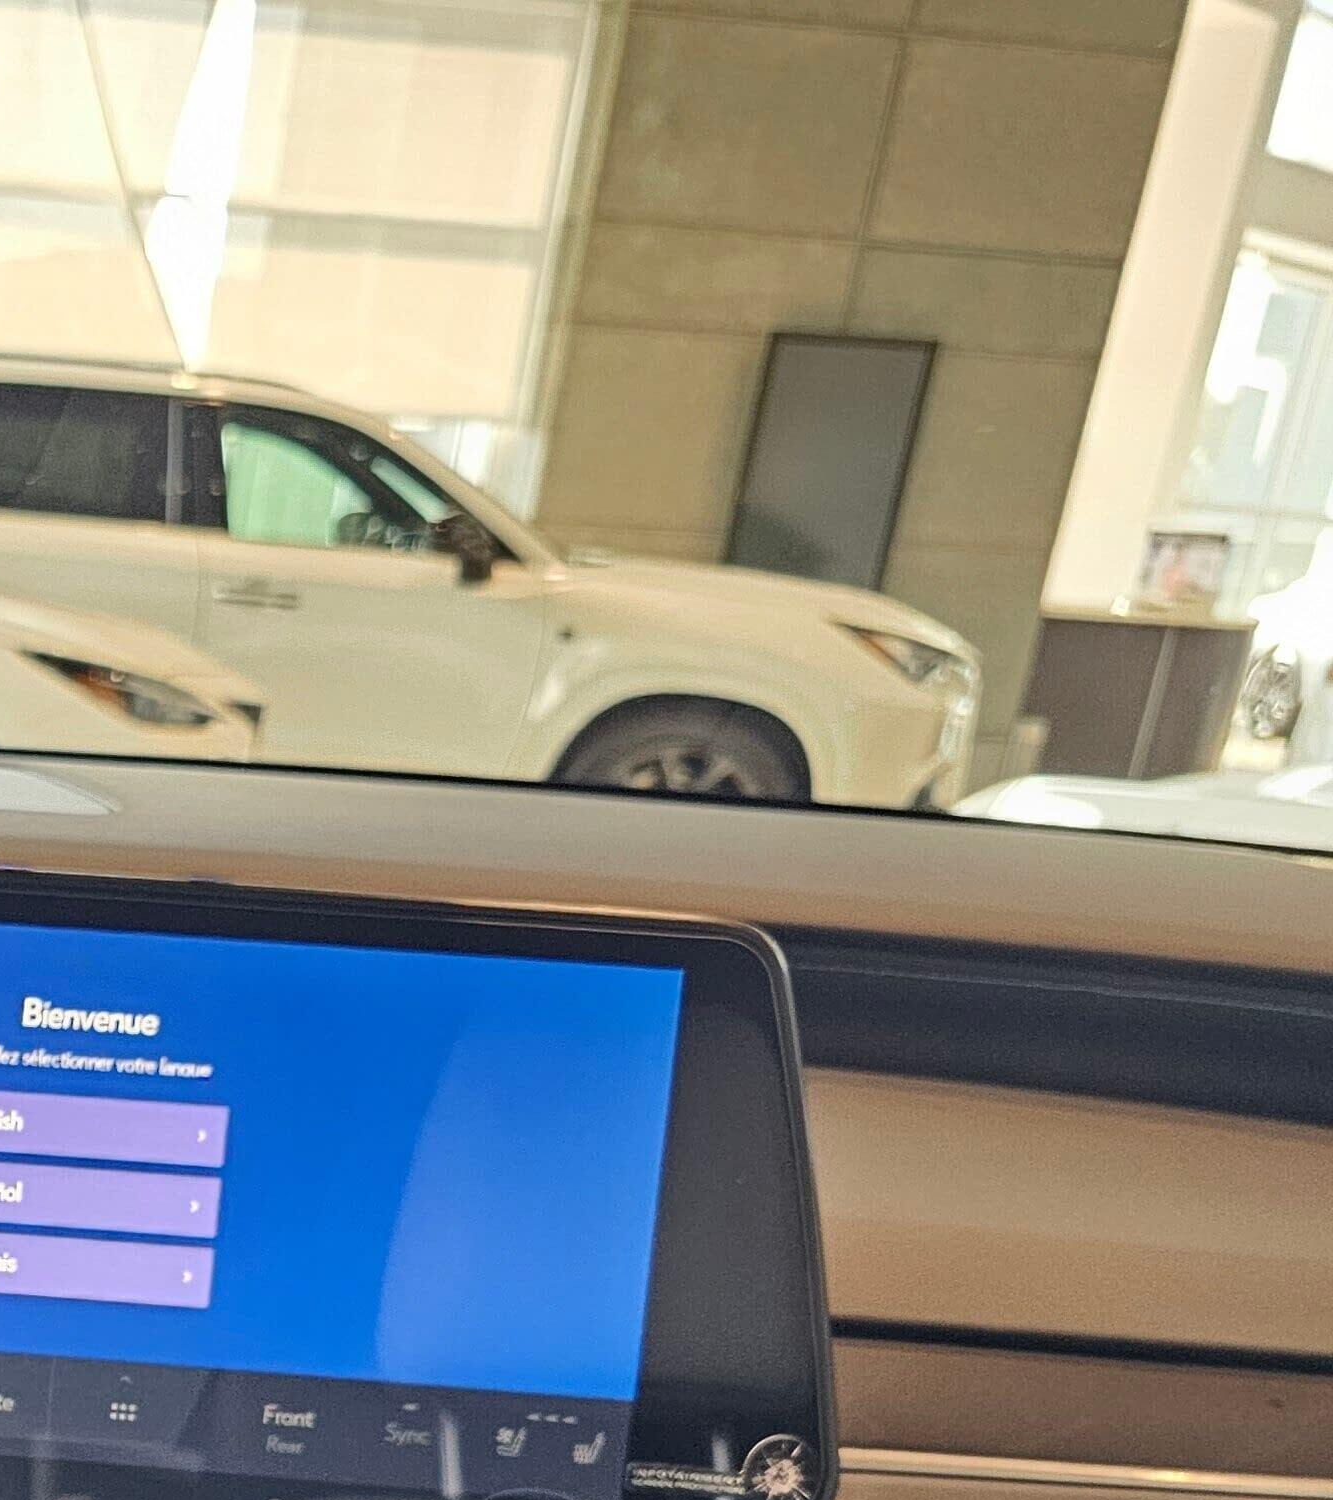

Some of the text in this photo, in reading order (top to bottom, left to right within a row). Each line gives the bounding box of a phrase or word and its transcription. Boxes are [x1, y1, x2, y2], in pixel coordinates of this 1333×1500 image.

[21, 996, 162, 1037] Bienvenue
[21, 1048, 115, 1073] sélectionner
[115, 1057, 157, 1075] votre
[262, 1404, 318, 1429] Front
[265, 1434, 305, 1455] Rear
[383, 1421, 431, 1447] Sync
